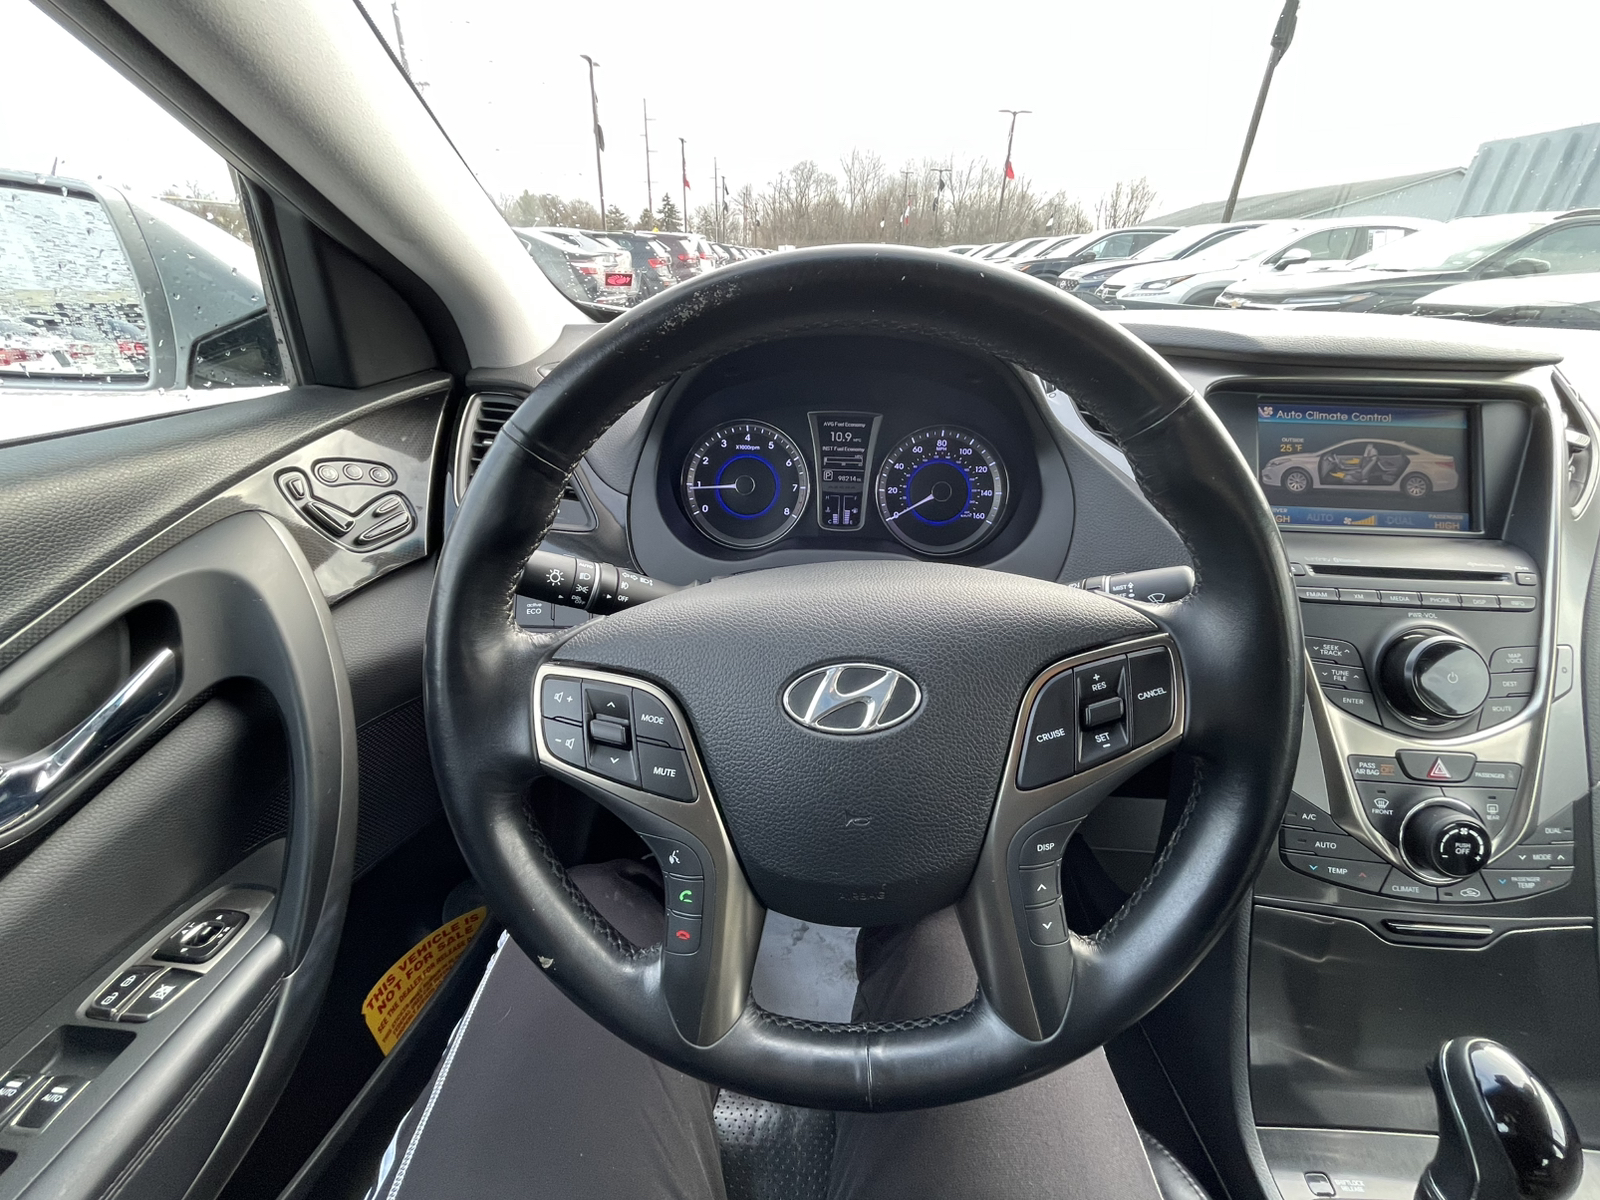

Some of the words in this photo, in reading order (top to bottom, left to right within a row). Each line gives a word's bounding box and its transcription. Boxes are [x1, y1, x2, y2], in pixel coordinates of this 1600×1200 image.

[1276, 410, 1302, 419] Auto
[1305, 411, 1348, 421] Climate
[1351, 412, 1392, 422] Control
[830, 431, 852, 442] 10.9
[721, 440, 727, 448] 3
[768, 441, 774, 449] 5
[1280, 444, 1292, 452] 25
[702, 457, 709, 465] 2
[786, 459, 792, 467] 6
[792, 484, 798, 492] 7
[702, 504, 709, 513] 0
[784, 508, 790, 516] 8
[1306, 513, 1334, 522] AUTO
[1387, 515, 1414, 525] DUAL
[1434, 521, 1460, 530] HIGH
[617, 595, 629, 603] OFF
[1092, 682, 1107, 691] RES
[1137, 687, 1167, 700] CANCEL
[641, 714, 664, 725] MODE
[1036, 728, 1066, 743] CRUISE
[1095, 732, 1110, 743] SET
[653, 767, 677, 778] MUTE
[1037, 842, 1055, 852] DISP
[1315, 841, 1337, 849] AUTO
[1327, 866, 1348, 875] TEMP
[1391, 885, 1419, 893] CLIMATE
[366, 974, 396, 1011] THIS
[398, 922, 460, 972] VEHICLE
[464, 914, 479, 925] IS
[377, 980, 402, 1015] NOT
[405, 953, 434, 980] FOR
[437, 925, 474, 952] SALE
[378, 1017, 390, 1034] SEE
[388, 1003, 400, 1017] THE
[399, 976, 423, 1002] DEALER
[422, 963, 436, 977] FOR
[41, 1093, 63, 1103] AUTO
